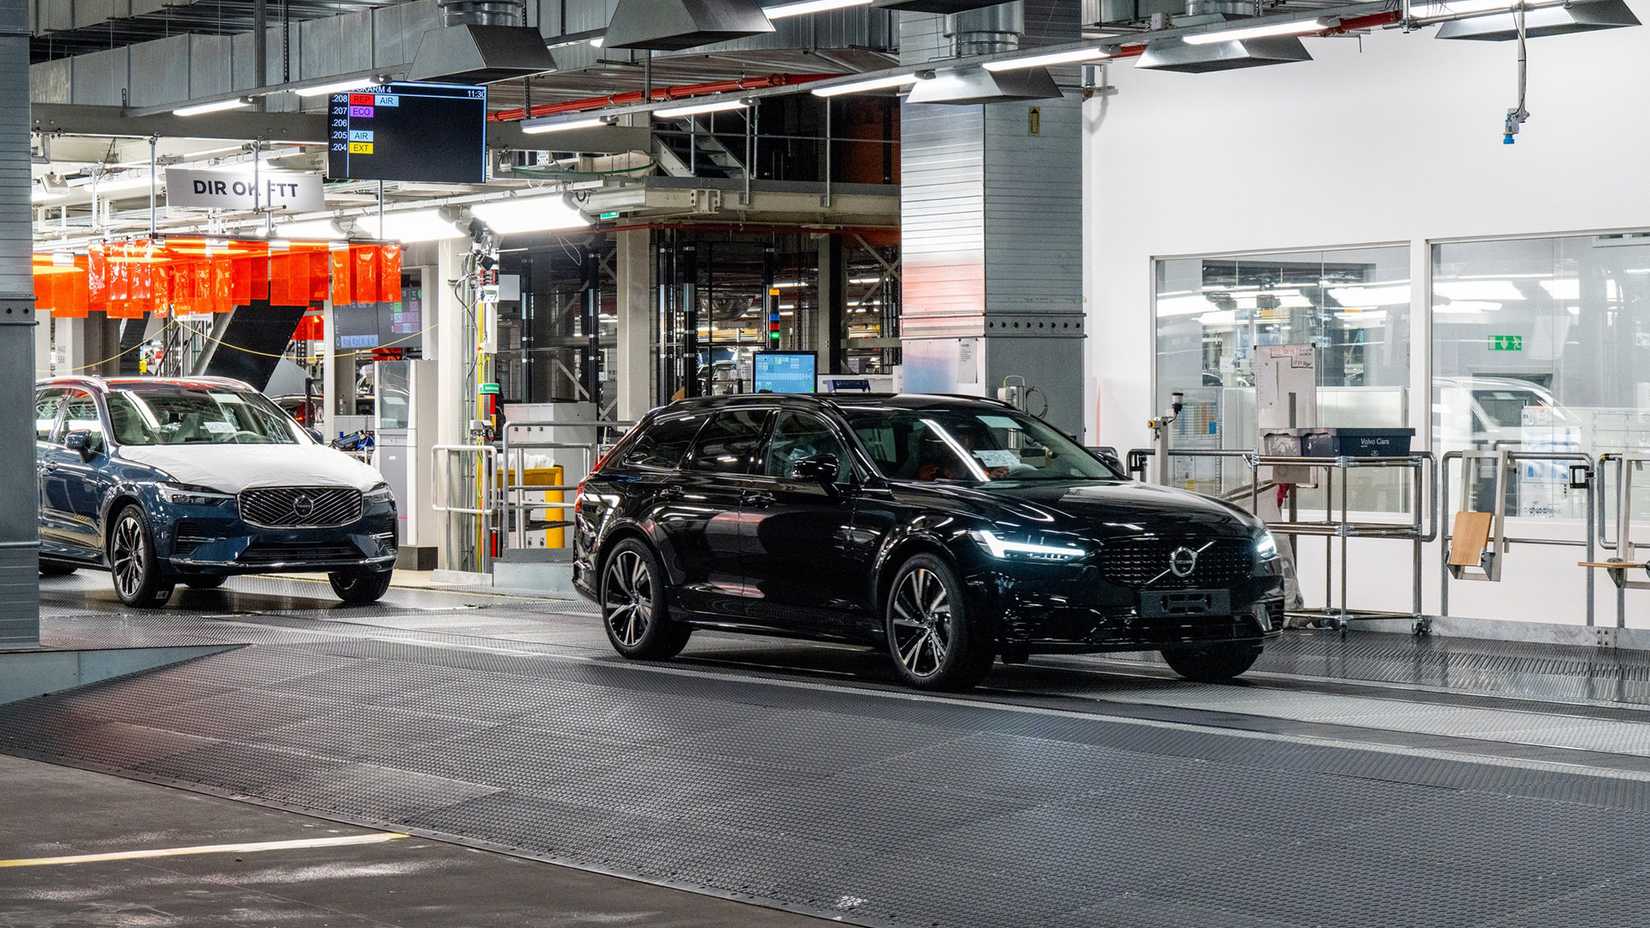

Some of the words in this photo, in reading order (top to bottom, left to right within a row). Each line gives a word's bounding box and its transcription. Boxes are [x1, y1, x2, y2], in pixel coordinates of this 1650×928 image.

[379, 97, 394, 105] AIR
[353, 107, 370, 116] ECO
[354, 132, 369, 140] AIR
[353, 144, 369, 152] EXT
[193, 180, 227, 195] DIR
[232, 181, 261, 196] OK
[1360, 437, 1376, 445] Volvo
[1376, 437, 1390, 445] Cars
